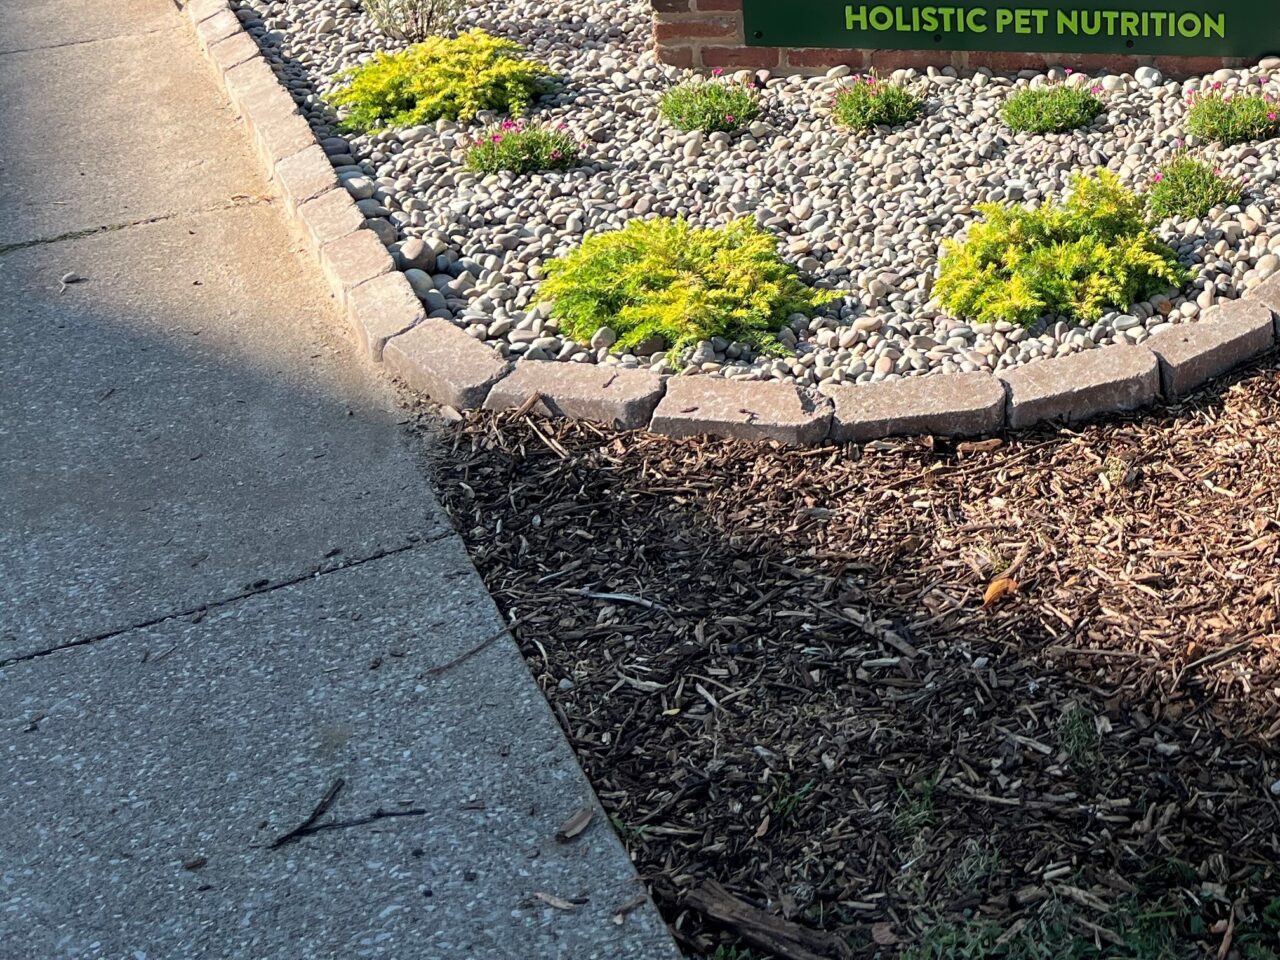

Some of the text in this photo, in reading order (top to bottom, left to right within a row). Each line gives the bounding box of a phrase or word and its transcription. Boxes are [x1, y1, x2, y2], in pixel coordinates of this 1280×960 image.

[844, 5, 1226, 39] HOLISTIC PET NUTRITION
